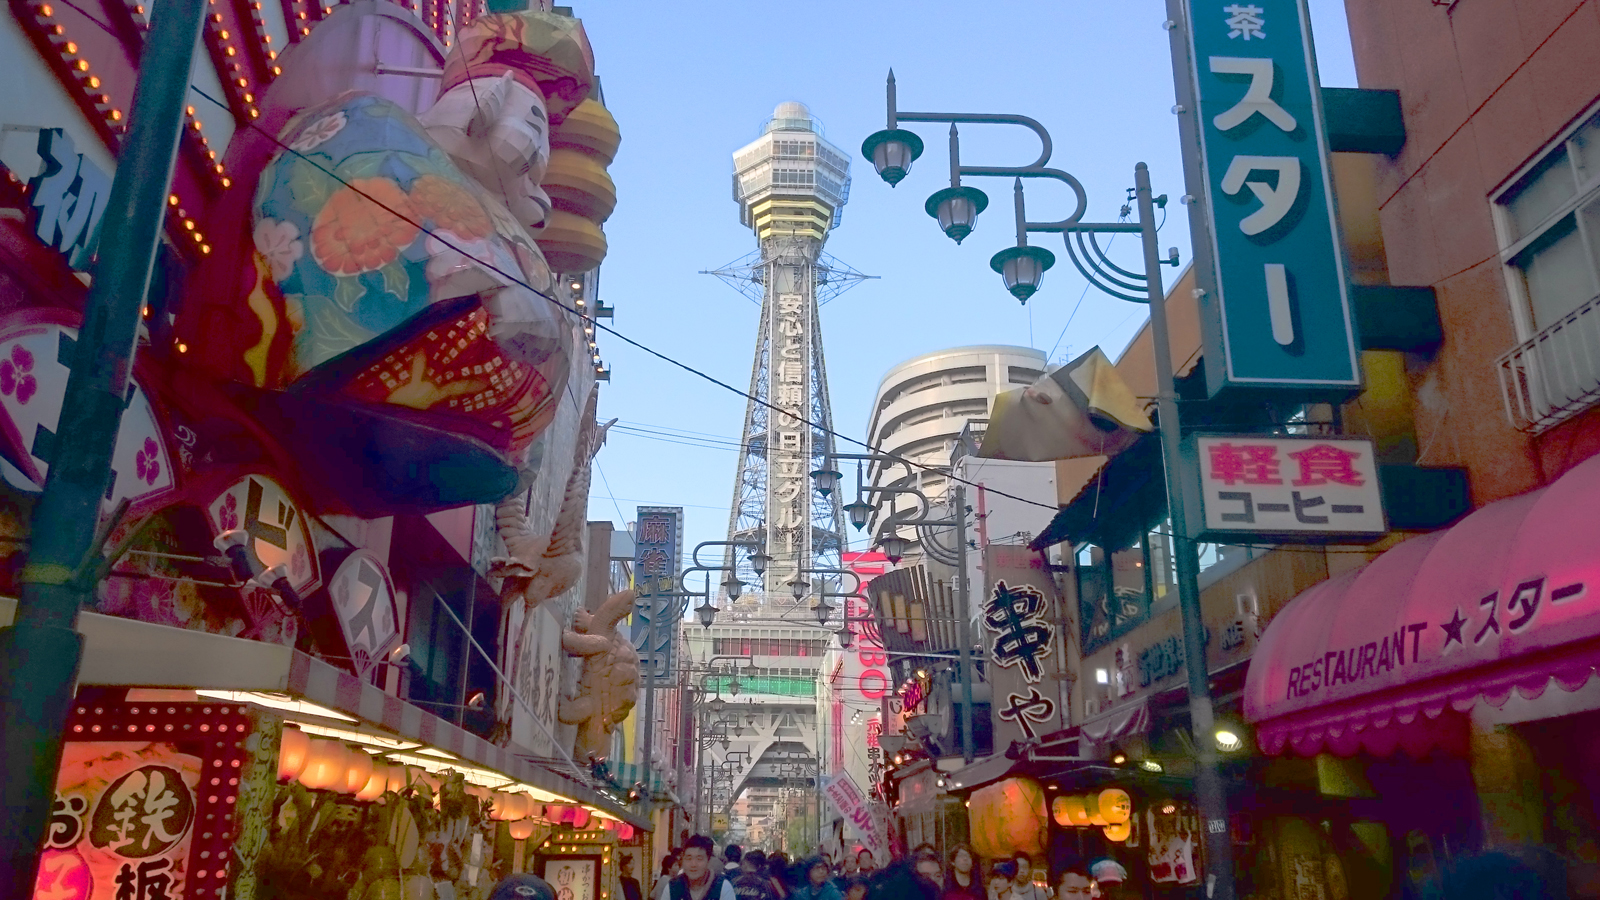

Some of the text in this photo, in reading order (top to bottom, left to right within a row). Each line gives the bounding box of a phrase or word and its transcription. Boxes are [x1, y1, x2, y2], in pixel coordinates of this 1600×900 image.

[1208, 56, 1301, 346] スター
[1207, 442, 1367, 487] 軽食
[1217, 490, 1364, 524] コーヒー
[637, 515, 671, 577] 麻雀
[1474, 575, 1584, 645] スター
[982, 579, 1056, 740] 串や
[1286, 621, 1428, 700] RESTAURANT
